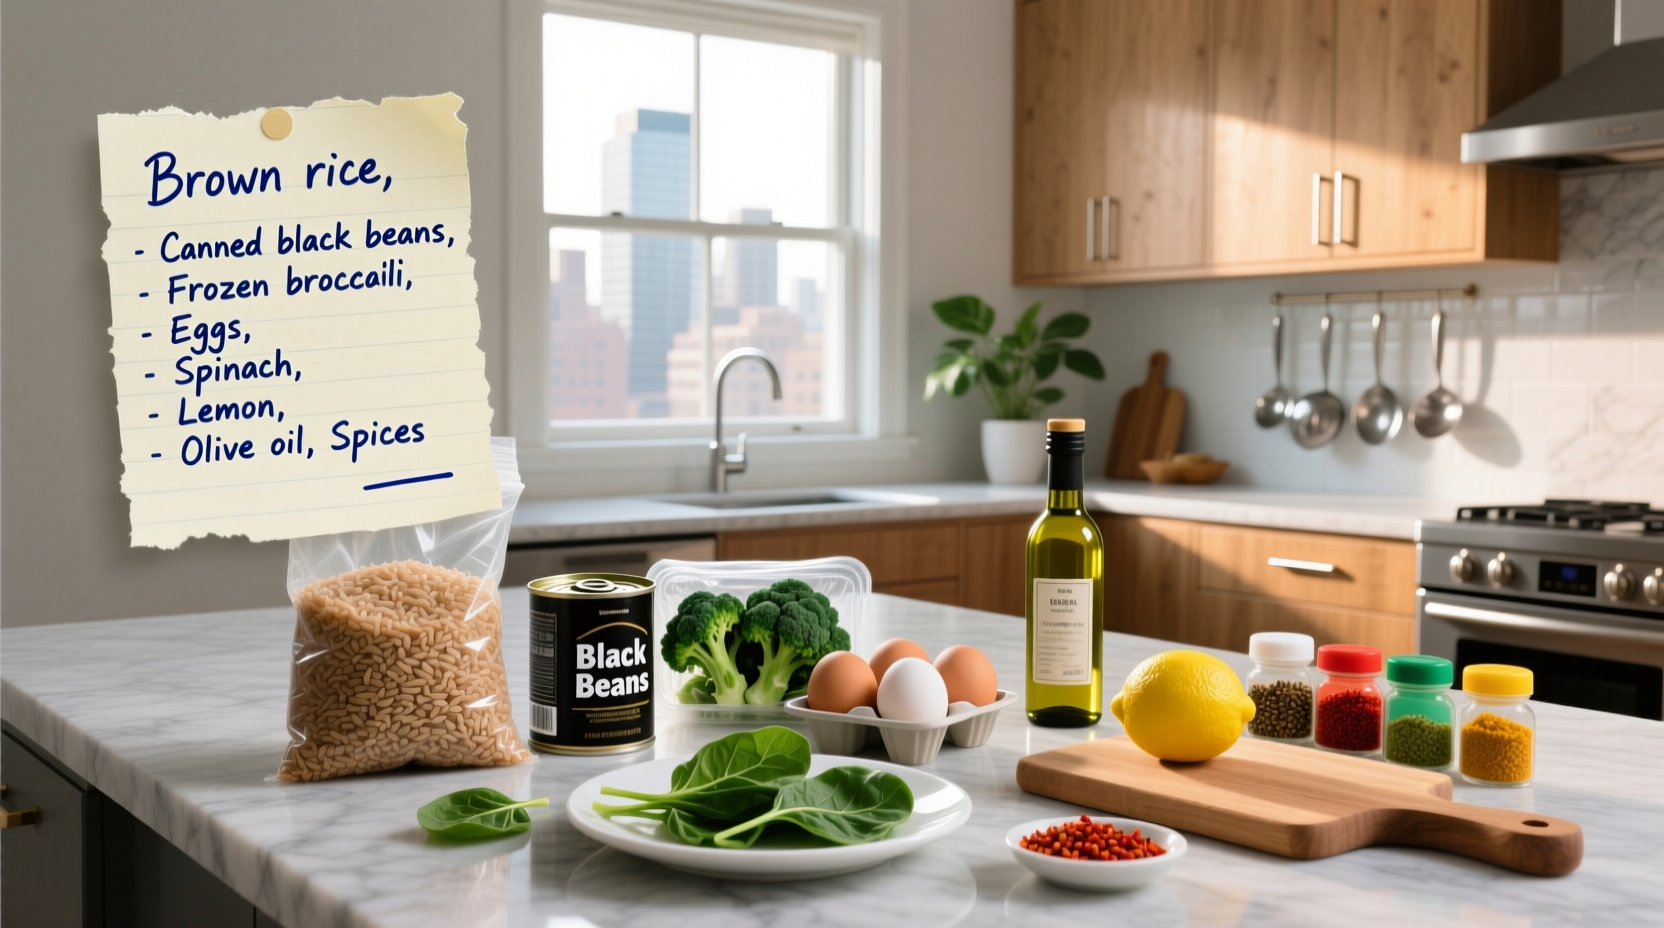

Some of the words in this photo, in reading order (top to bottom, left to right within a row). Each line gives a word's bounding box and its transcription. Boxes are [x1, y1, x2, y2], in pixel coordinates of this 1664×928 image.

[143, 151, 282, 207] Brown
[306, 152, 392, 193] rice,
[160, 225, 263, 264] Canned
[277, 218, 353, 255] black
[365, 218, 455, 249] beans,
[167, 273, 269, 305] Frozen
[286, 258, 413, 296] broccaili,
[170, 313, 251, 356] Eggs,
[174, 348, 302, 398] Spinach,
[178, 396, 285, 426] Lemon,
[181, 434, 255, 466] Olive
[270, 424, 314, 460] oil,
[330, 419, 425, 464] Spices
[576, 637, 647, 670] Black
[575, 671, 649, 699] Beans
